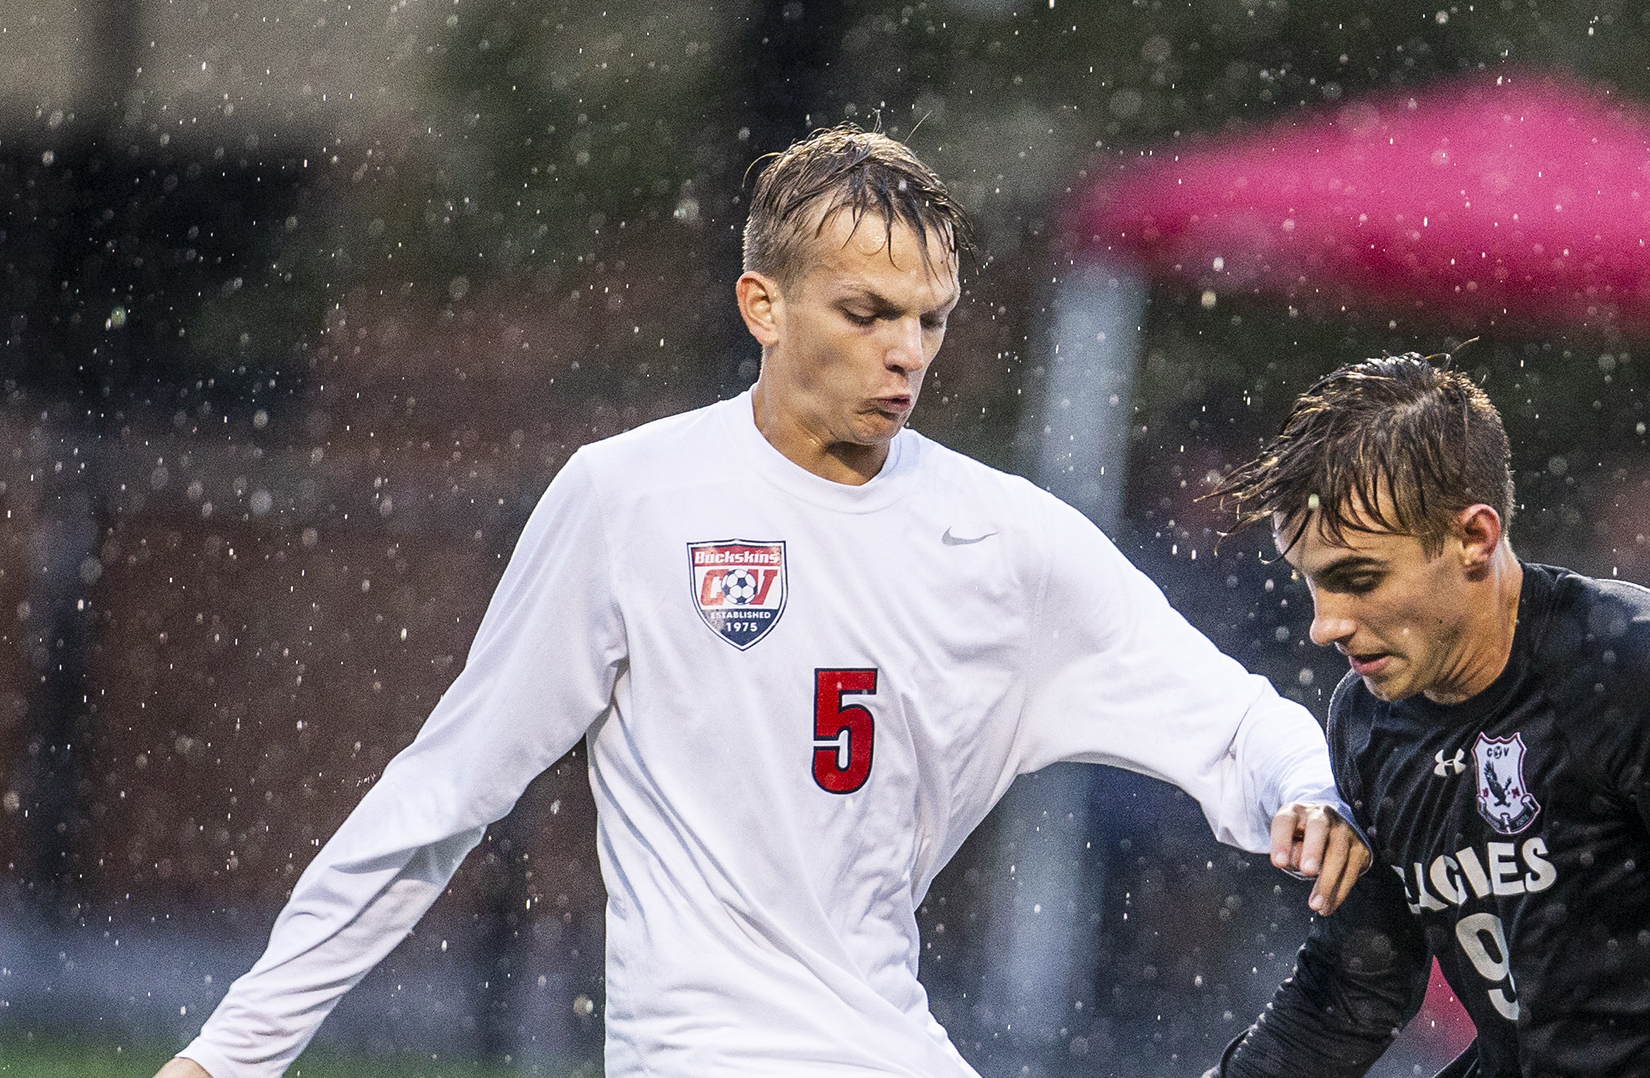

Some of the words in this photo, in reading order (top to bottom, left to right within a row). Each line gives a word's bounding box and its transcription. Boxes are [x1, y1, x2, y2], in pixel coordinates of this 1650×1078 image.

[694, 550, 780, 565] Buckskins
[710, 611, 772, 620] ESTABLISHED
[726, 621, 759, 633] 1975
[810, 667, 878, 796] 5
[1391, 836, 1558, 915] GLES
[1455, 911, 1521, 1021] 9
